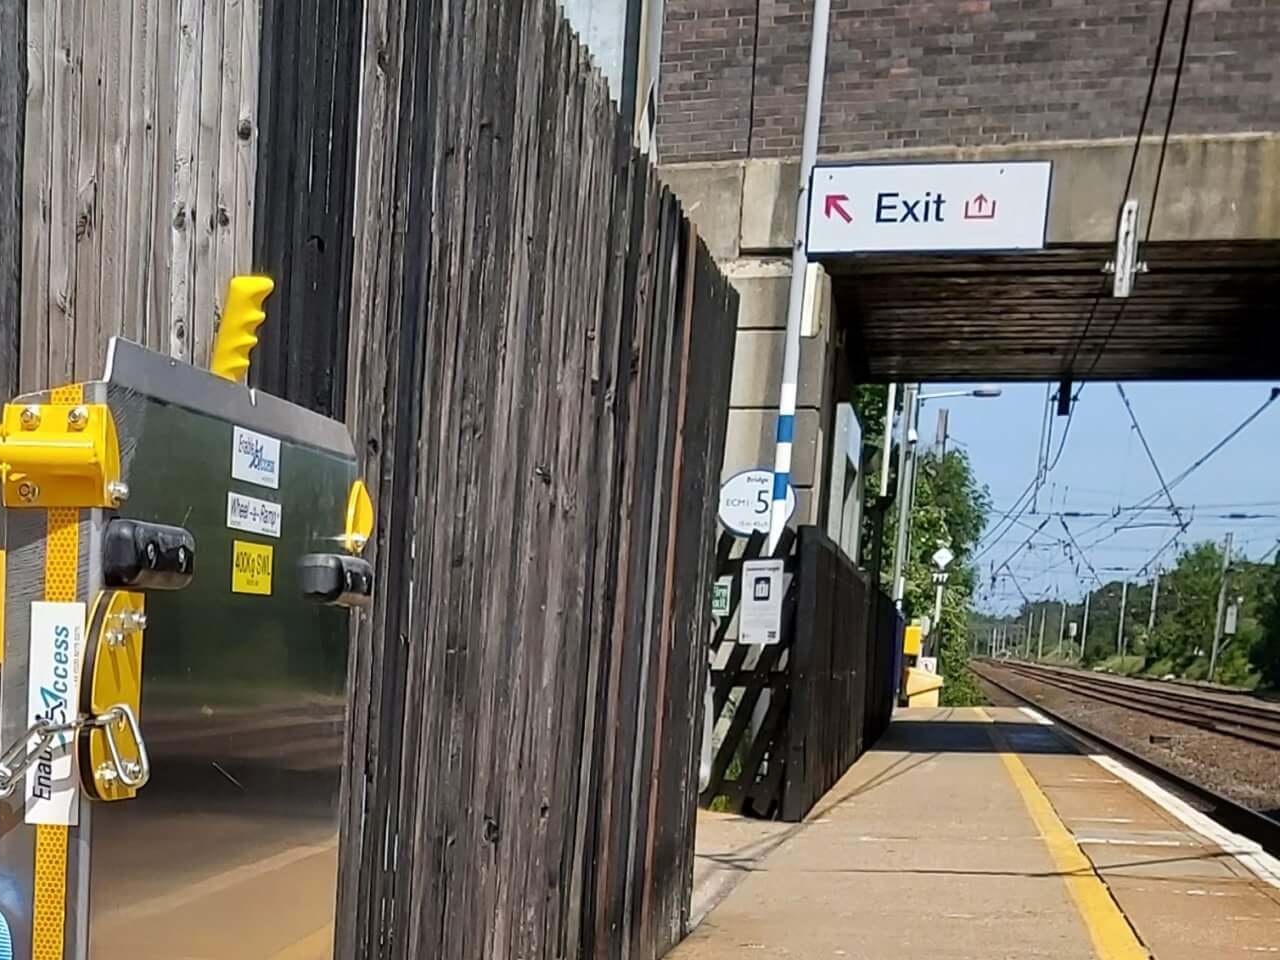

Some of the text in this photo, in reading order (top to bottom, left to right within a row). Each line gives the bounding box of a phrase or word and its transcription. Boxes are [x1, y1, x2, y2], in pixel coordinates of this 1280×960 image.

[876, 192, 946, 223] Exit
[746, 476, 769, 485] Bridge
[754, 490, 769, 514] 5
